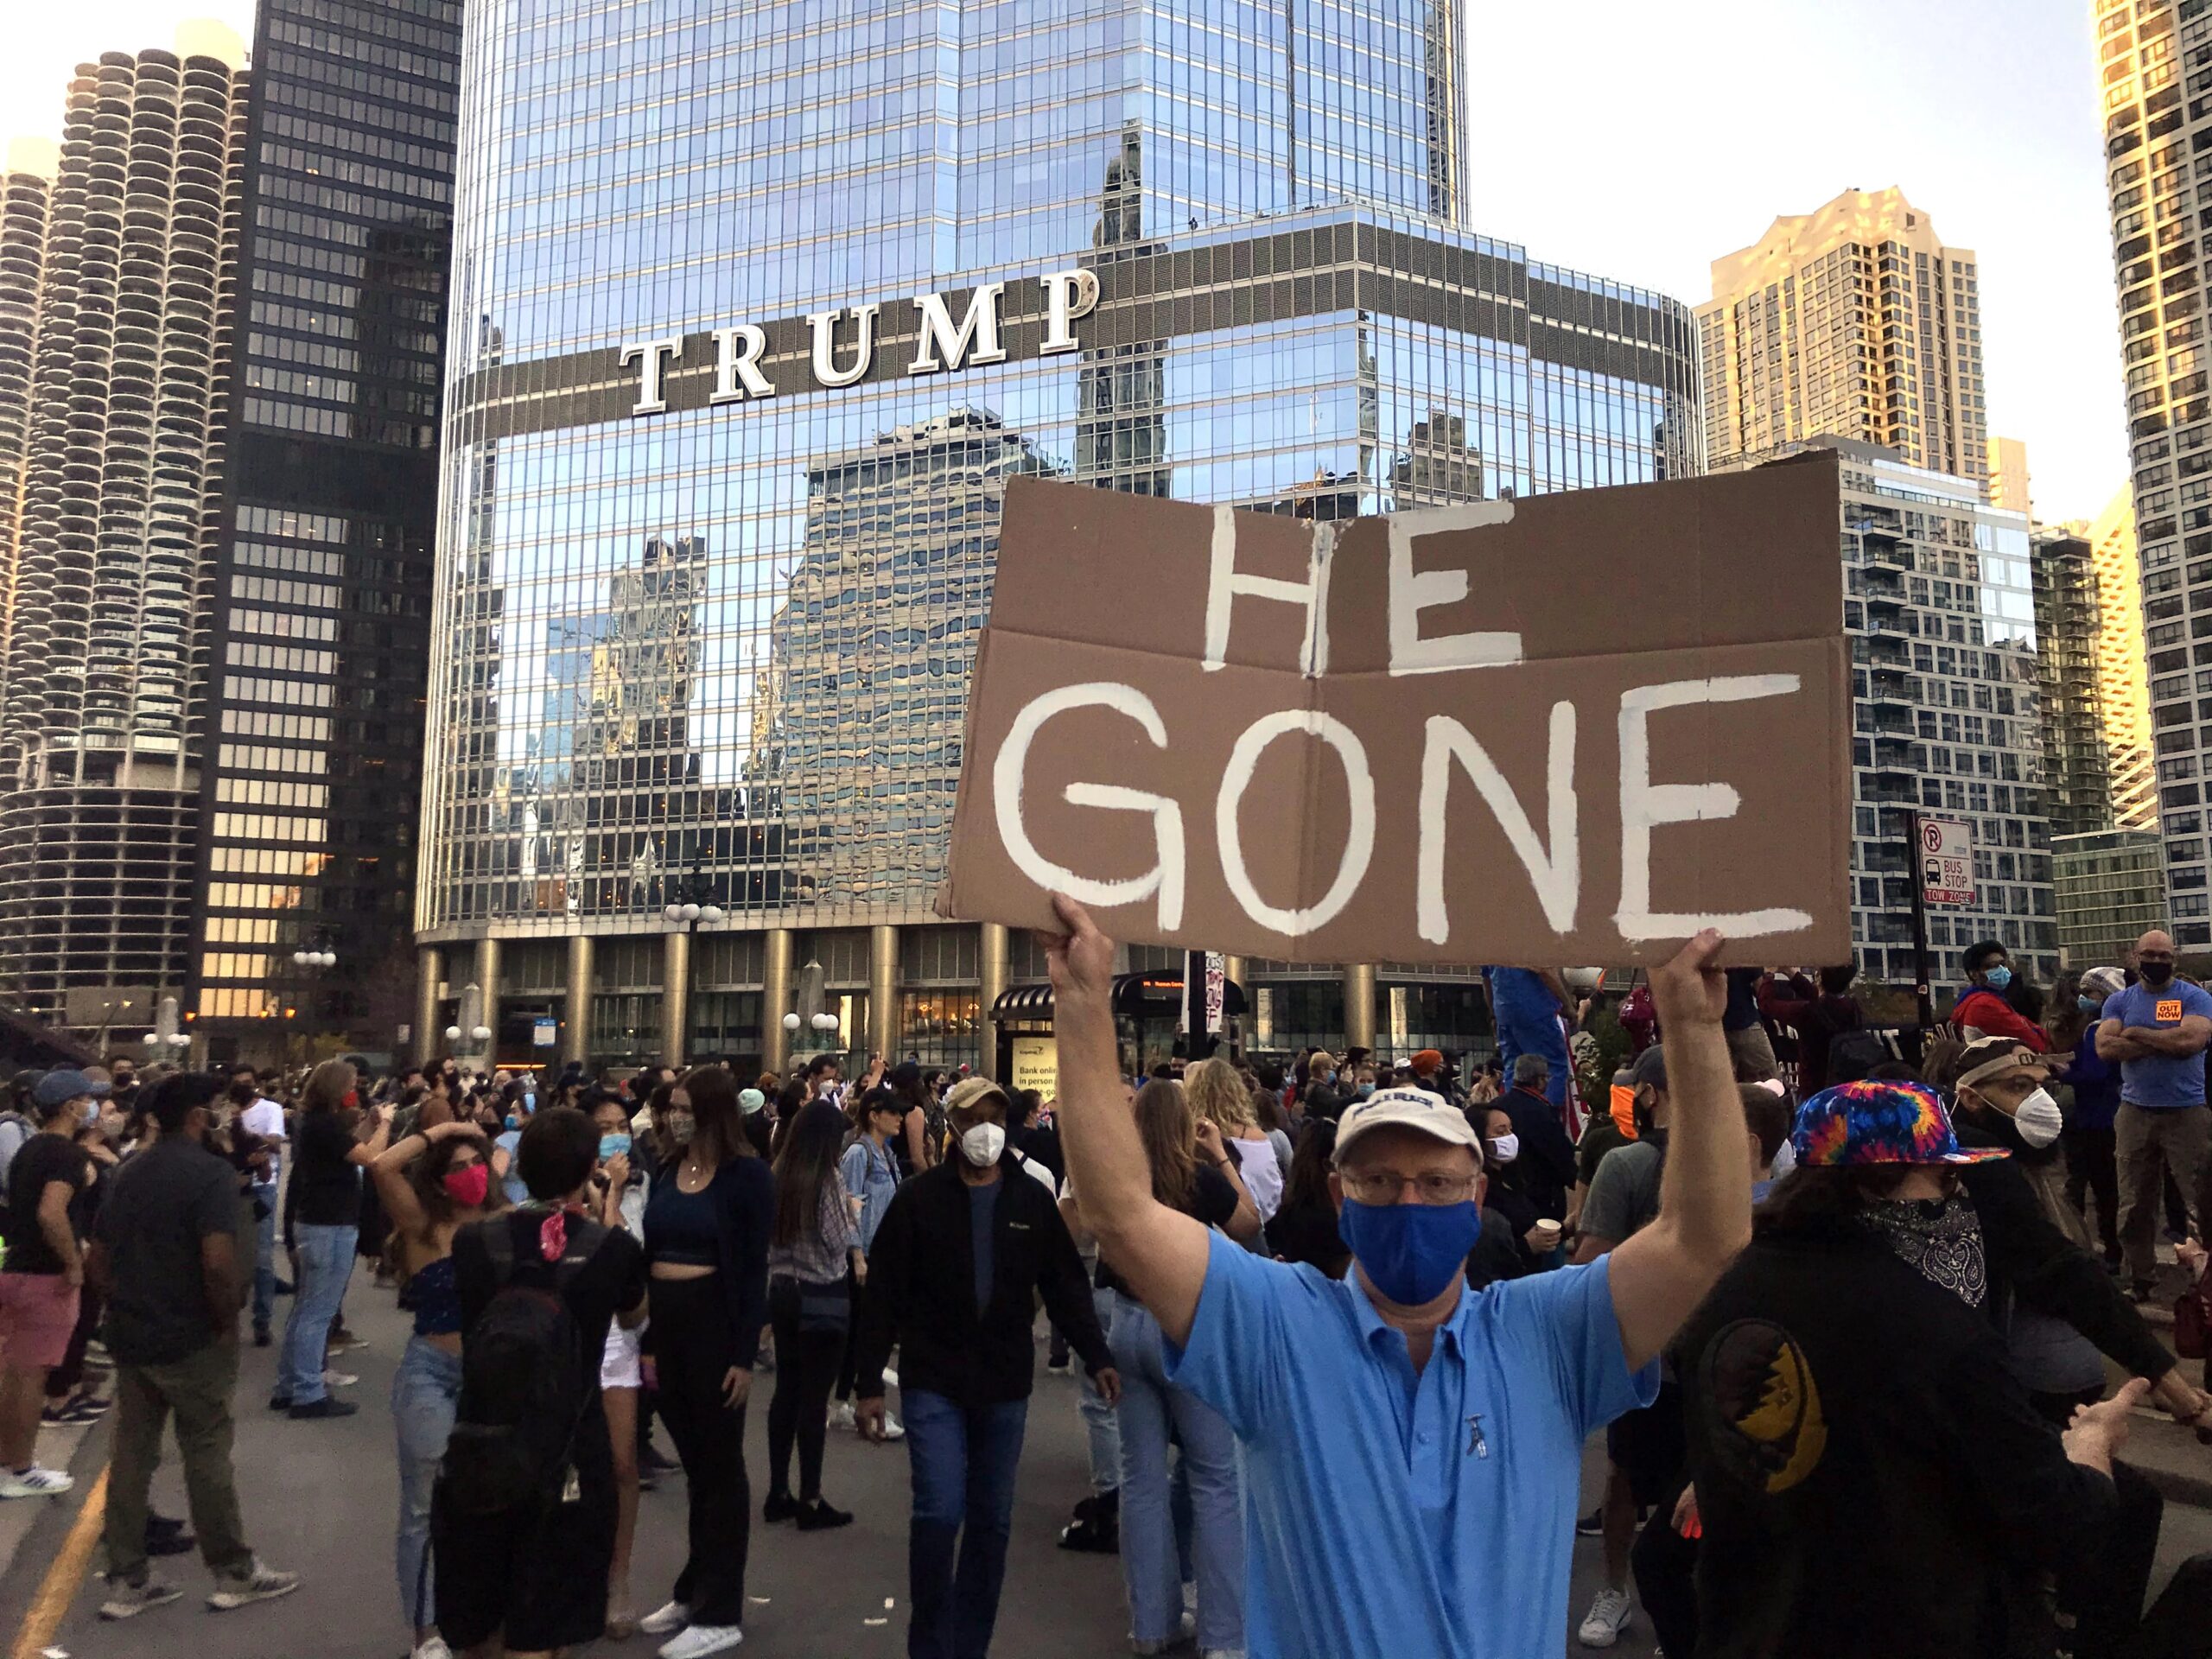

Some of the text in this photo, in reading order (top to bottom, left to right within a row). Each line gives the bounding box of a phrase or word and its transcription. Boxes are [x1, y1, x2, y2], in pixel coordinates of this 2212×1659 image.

[620, 269, 1100, 416] TRUMP
[1201, 500, 1523, 677] HE
[993, 673, 1813, 945] GONE
[1927, 889, 1971, 903] TOW ZONE
[1944, 860, 1963, 874] BUS
[1945, 874, 1967, 888] STOP
